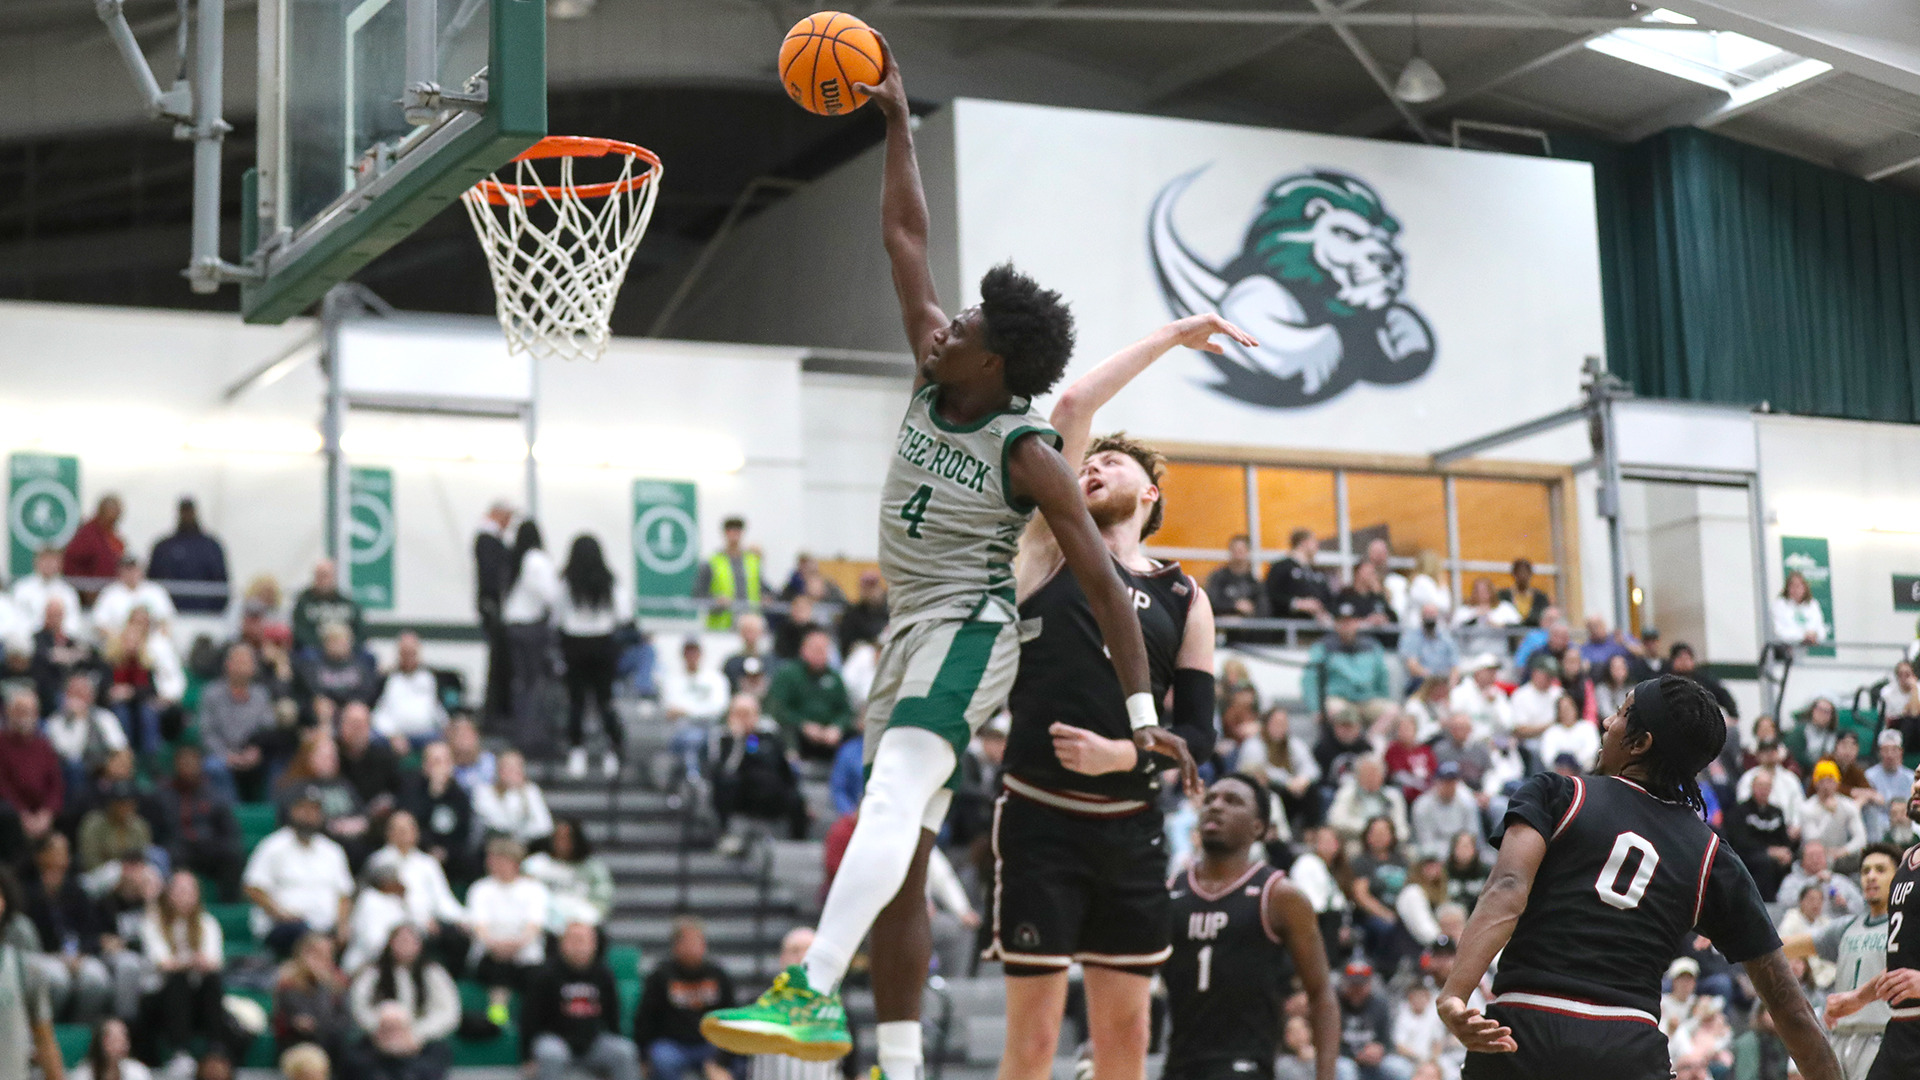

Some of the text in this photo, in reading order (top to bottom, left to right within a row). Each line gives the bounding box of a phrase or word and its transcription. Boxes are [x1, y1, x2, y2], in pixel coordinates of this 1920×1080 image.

[898, 425, 992, 494] THE ROCK
[900, 483, 934, 540] 4
[1594, 830, 1660, 910] 0
[1890, 881, 1914, 906] IUP
[1187, 911, 1229, 940] IUP
[1887, 911, 1904, 953] 2
[1197, 945, 1213, 992] 1
[1853, 957, 1862, 989] 1
